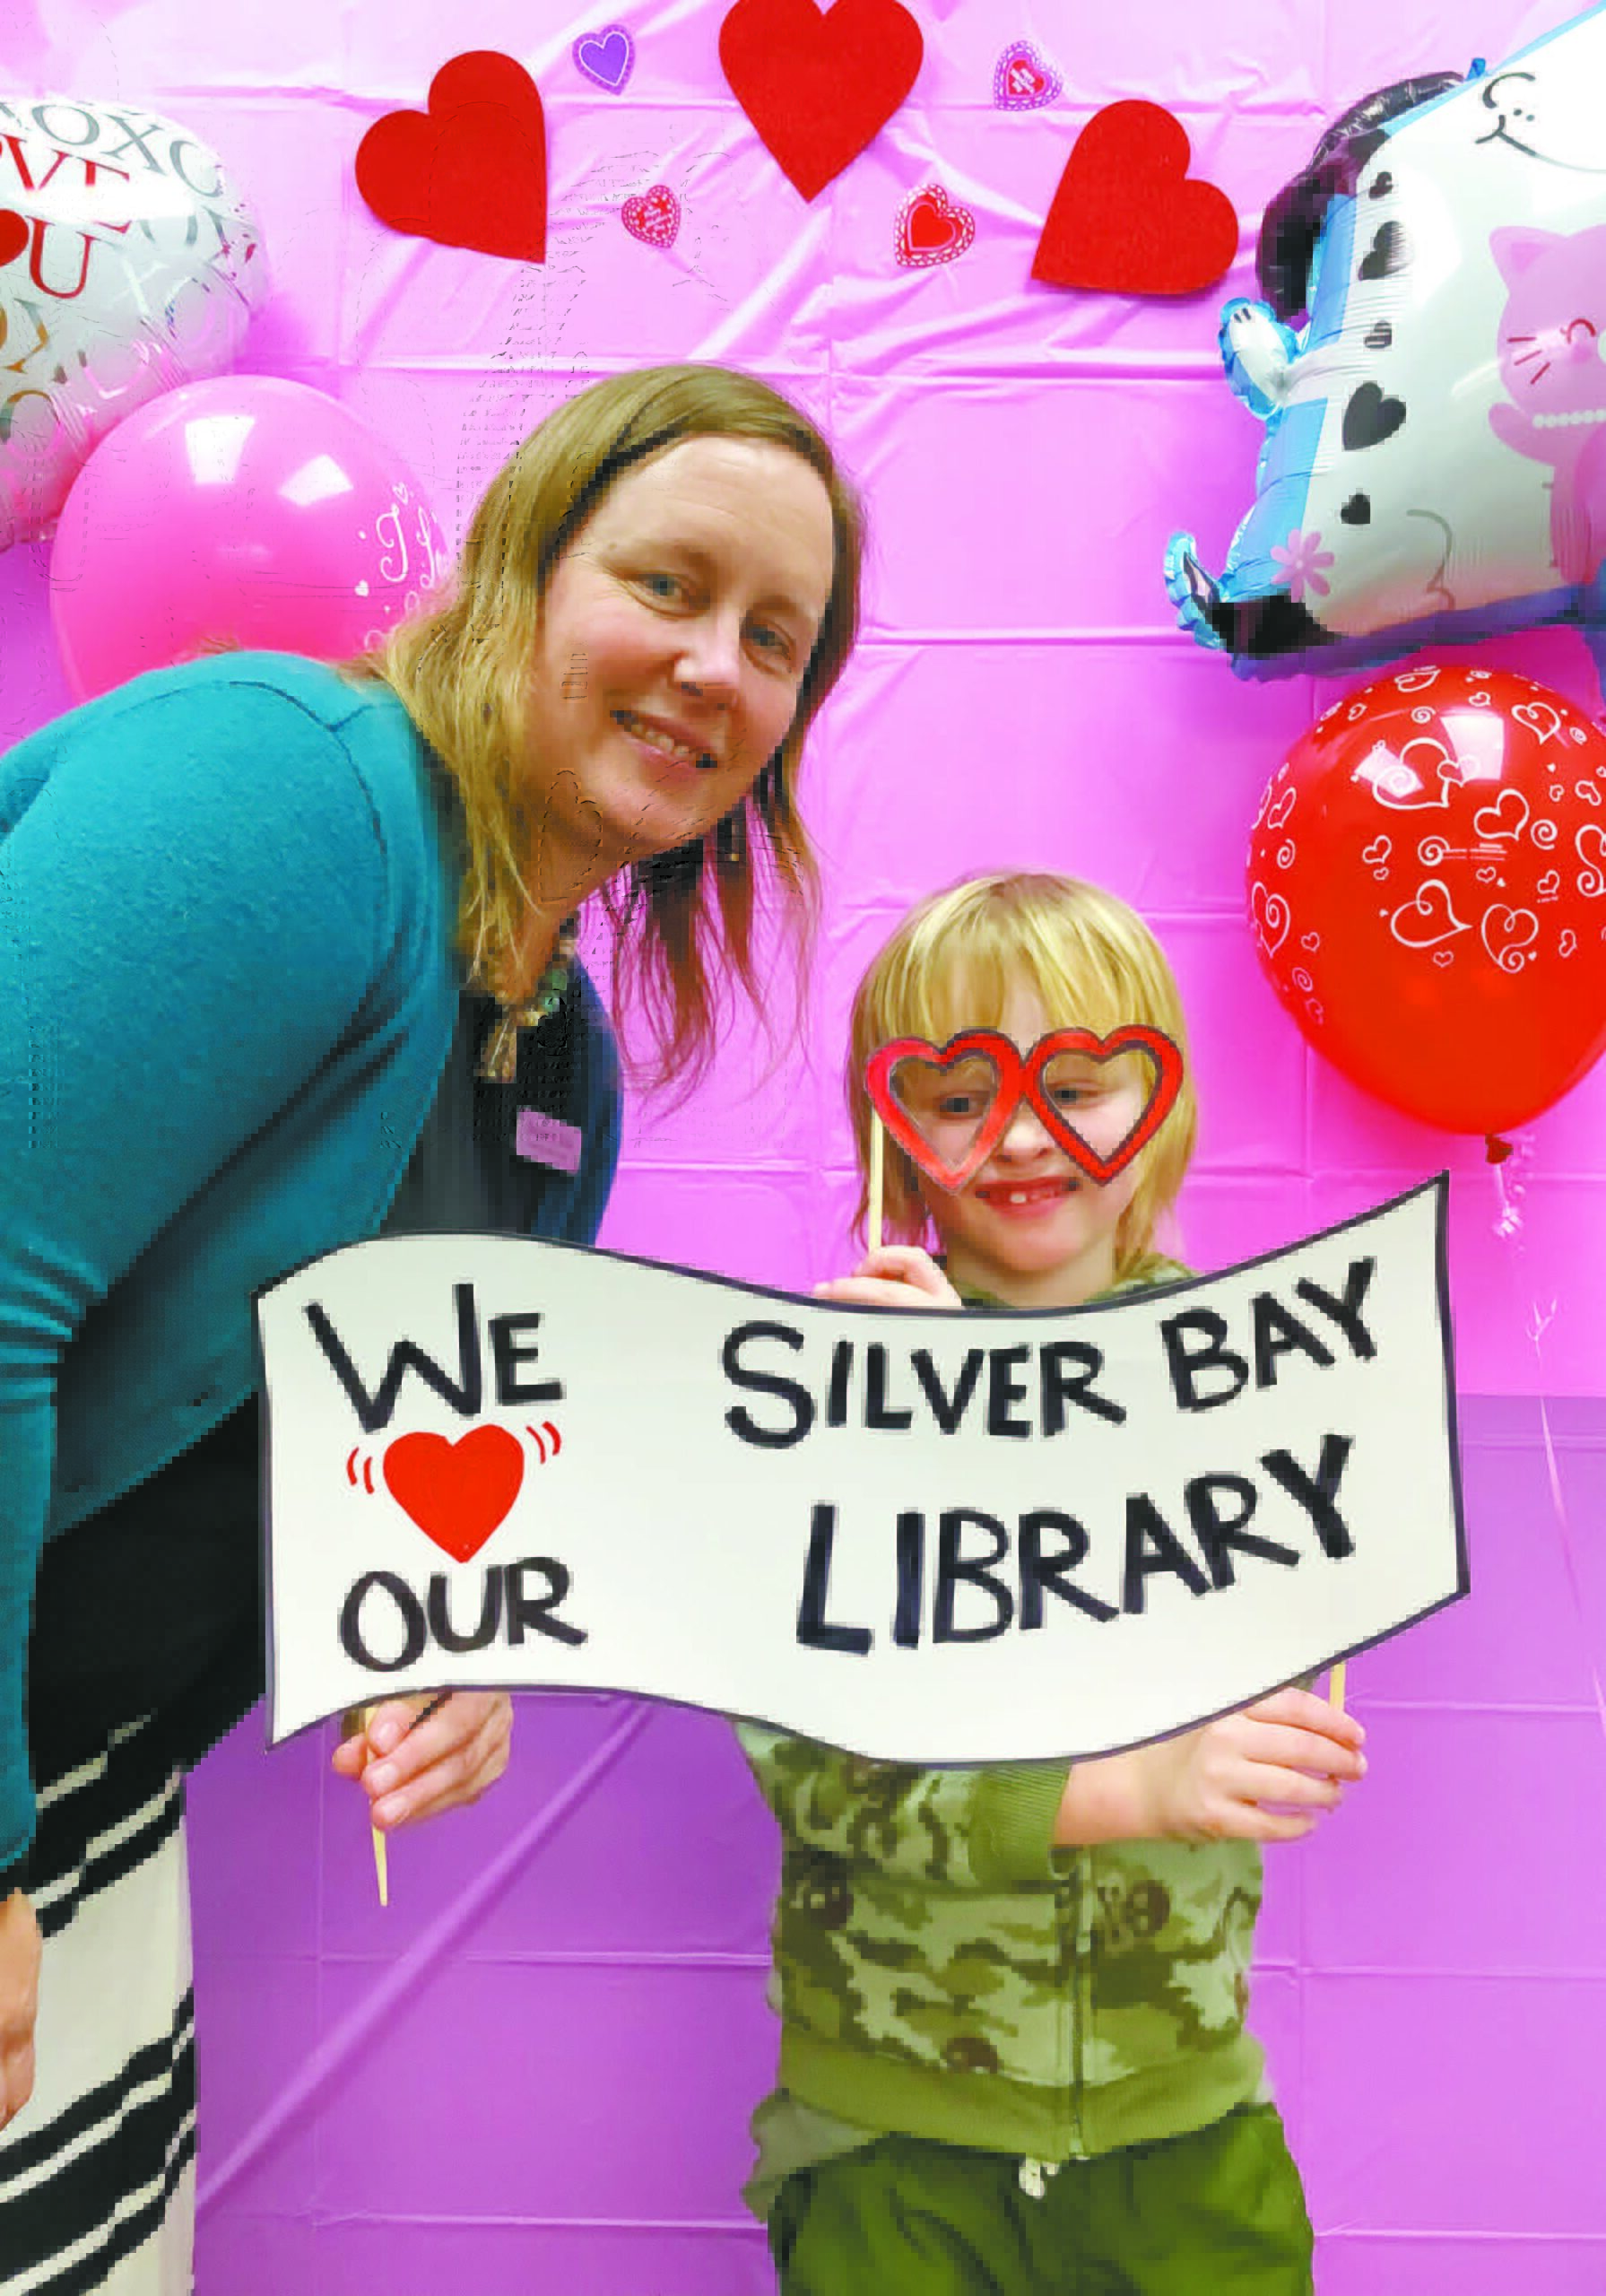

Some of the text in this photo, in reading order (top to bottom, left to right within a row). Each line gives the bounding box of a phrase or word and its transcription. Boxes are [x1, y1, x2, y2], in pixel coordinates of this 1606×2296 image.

[304, 1283, 563, 1433] WE
[721, 1257, 1377, 1450] SILVER BAY
[338, 1556, 588, 1674] OUR
[795, 1433, 1356, 1657] LIBRARY
